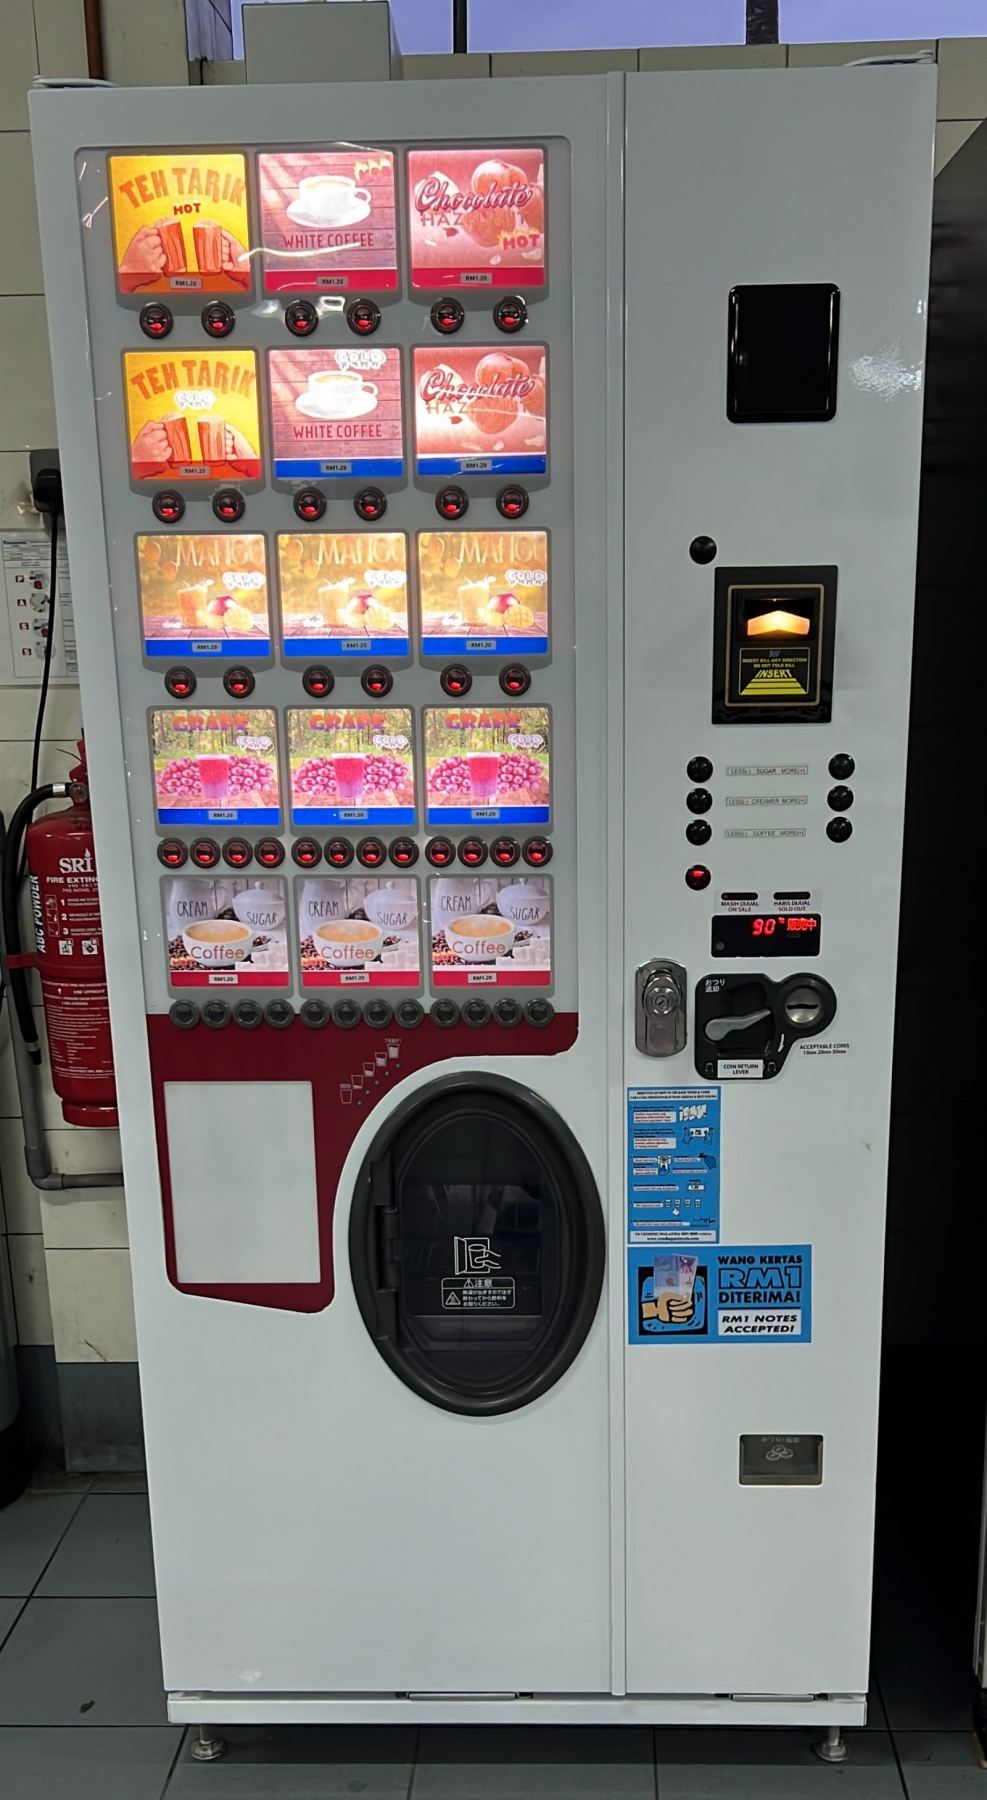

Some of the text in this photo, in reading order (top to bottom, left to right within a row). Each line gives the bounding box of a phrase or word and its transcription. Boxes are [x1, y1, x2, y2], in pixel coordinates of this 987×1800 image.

[119, 168, 246, 208] TEH TARIK
[415, 177, 533, 213] Chocolate
[173, 203, 201, 215] HOT
[283, 233, 374, 249] WHITE COFFEE
[503, 234, 540, 250] HOT
[337, 351, 383, 367] COLD
[130, 360, 256, 400] TEH TARIK
[420, 369, 535, 403] Chocolate
[293, 424, 382, 439] WHITE COFFEE
[507, 570, 546, 585] COLD
[755, 669, 793, 678] INSERT
[172, 714, 249, 731] GRAPE
[308, 712, 385, 730] GRAPE
[444, 711, 522, 729] GRAPE
[59, 849, 94, 874] SRI
[46, 876, 65, 884] FIRE
[30, 875, 44, 926] POWDER
[61, 899, 66, 907] 1
[441, 896, 472, 912] CREAM
[177, 900, 209, 917] CREAM
[308, 901, 339, 917] CREAM
[509, 906, 541, 921] SUGAR
[61, 913, 68, 921] 2
[246, 911, 277, 926] SUGAR
[377, 911, 408, 926] SUGAR
[62, 927, 70, 935] 3
[752, 918, 776, 936] 90
[190, 946, 245, 959] Coffee
[321, 946, 375, 959] Coffee
[452, 941, 506, 954] Coffee
[718, 1255, 803, 1265] WANG KERTAS
[474, 1279, 493, 1289] 注意
[718, 1265, 803, 1289] RM1
[719, 1292, 801, 1303] DITERIMA!
[722, 1315, 798, 1323] RM1 NOTES
[724, 1325, 795, 1333] ACCEPTED!
